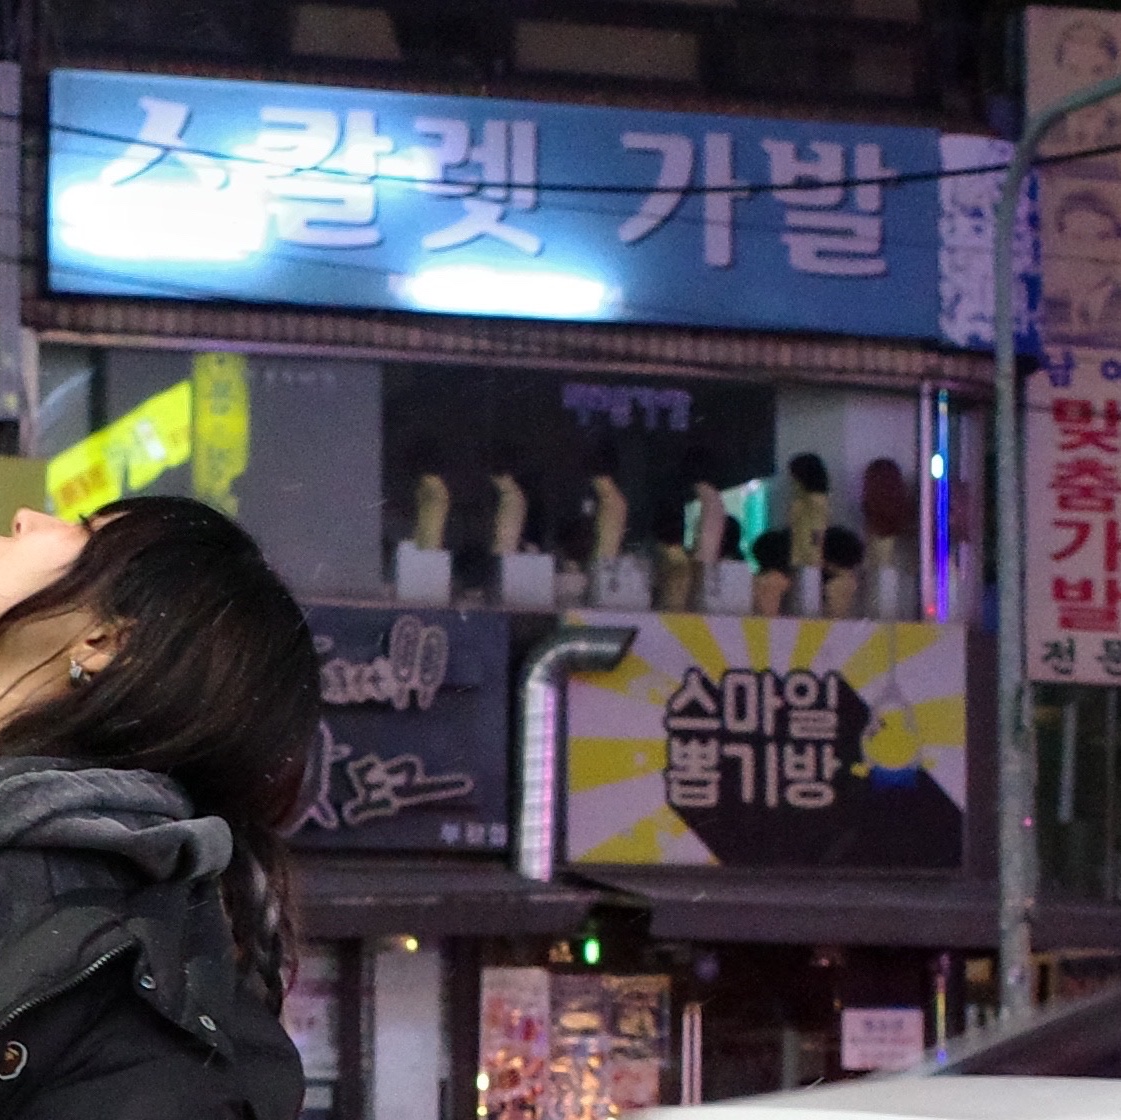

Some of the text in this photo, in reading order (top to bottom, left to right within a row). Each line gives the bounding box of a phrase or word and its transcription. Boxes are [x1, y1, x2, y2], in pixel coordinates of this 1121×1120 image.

[618, 131, 899, 276] 가발
[668, 672, 839, 740] 스마일
[668, 738, 842, 808] 뽑기방
